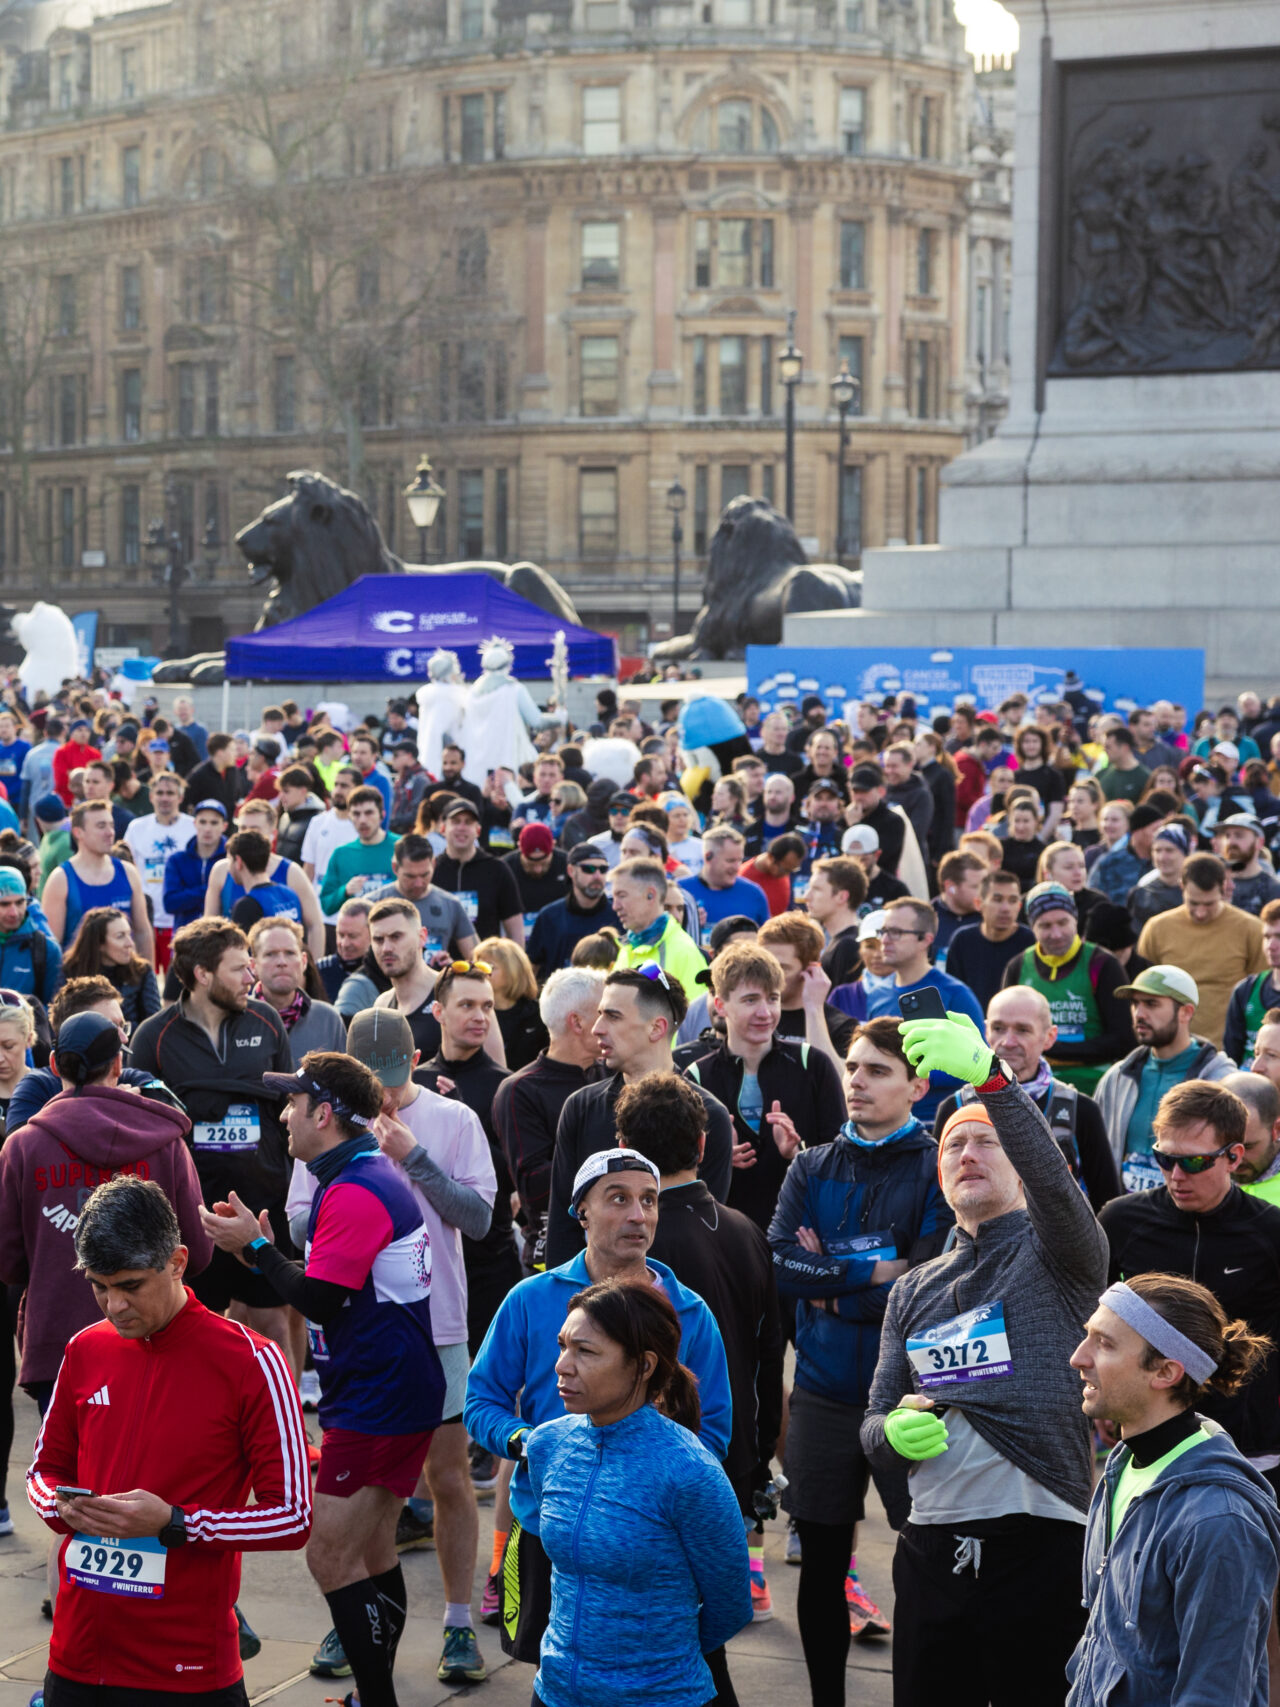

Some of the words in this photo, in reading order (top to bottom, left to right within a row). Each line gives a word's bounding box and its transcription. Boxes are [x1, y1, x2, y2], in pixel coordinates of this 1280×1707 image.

[207, 1127, 248, 1141] 2268
[42, 1204, 80, 1238] JAP
[928, 1339, 990, 1370] 3272
[968, 1364, 1010, 1378] #WINTERRUN
[80, 1545, 143, 1578] 2929
[112, 1582, 156, 1594] #WINTERRU
[365, 1603, 382, 1645] 2XU
